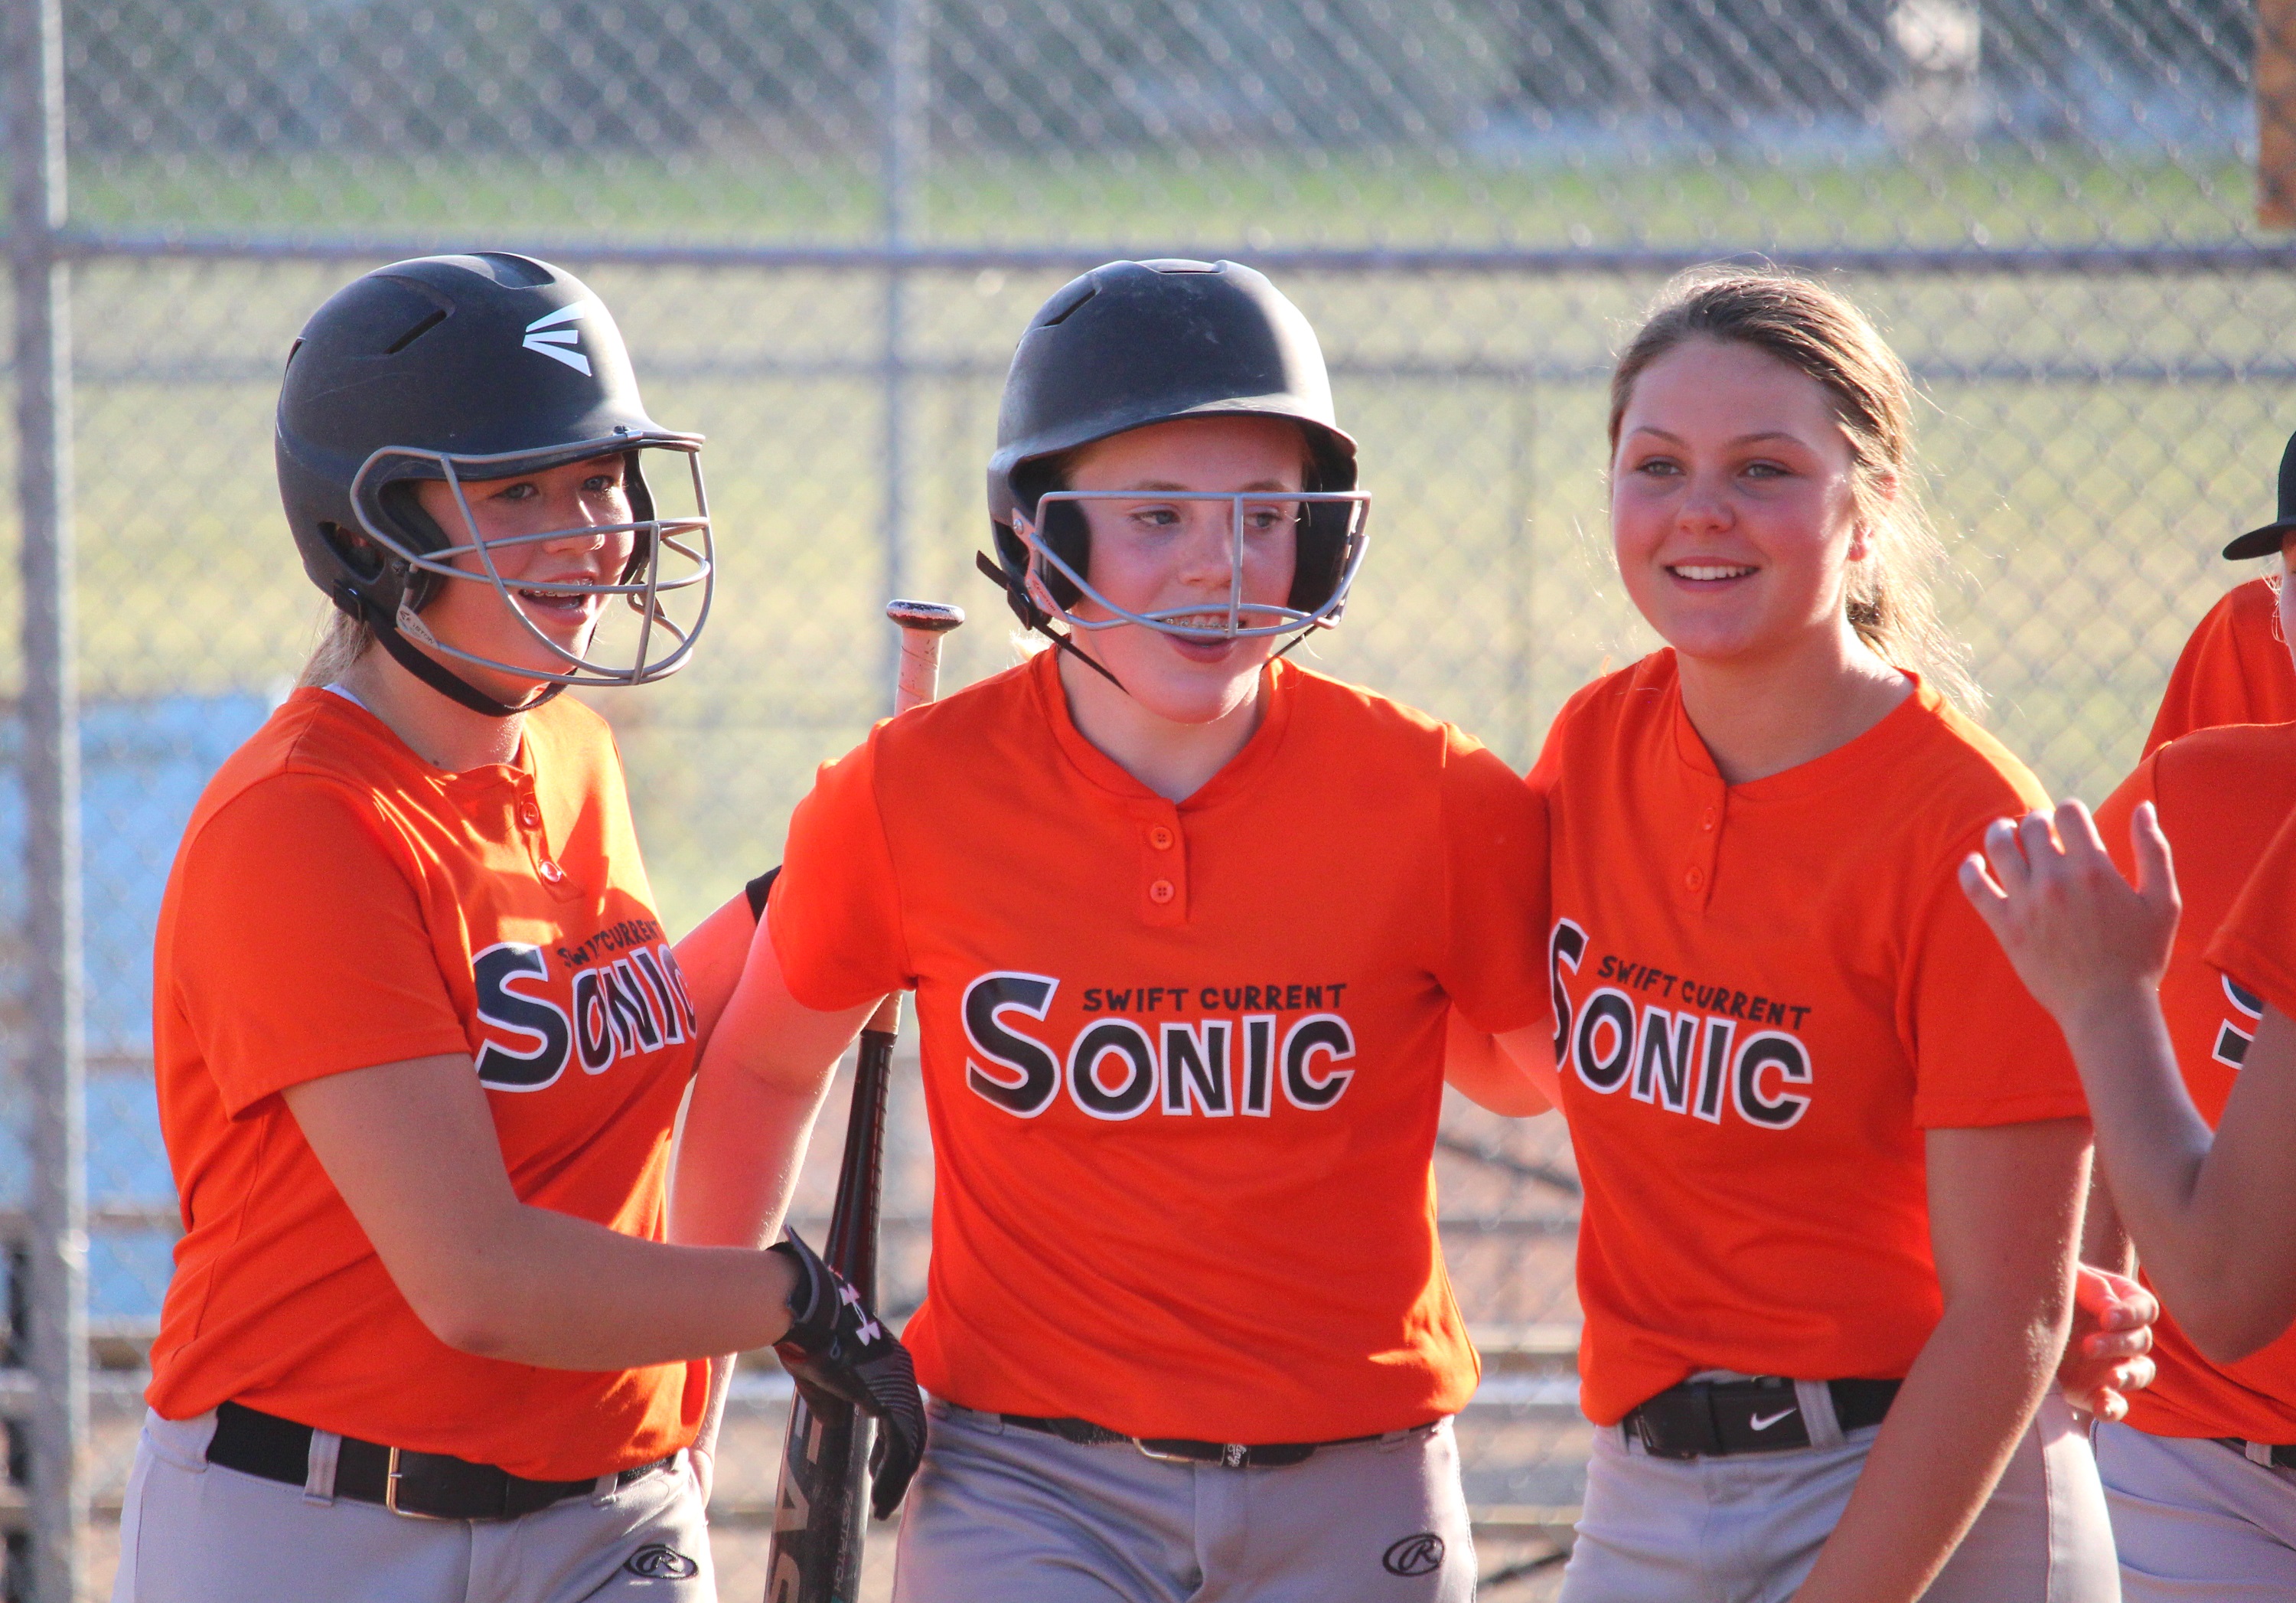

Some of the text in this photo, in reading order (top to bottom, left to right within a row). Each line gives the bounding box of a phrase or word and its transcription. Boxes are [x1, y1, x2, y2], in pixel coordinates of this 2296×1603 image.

[960, 971, 1356, 1121] SONIC
[1082, 984, 1347, 1012] SWIFT CURRENT
[1548, 917, 1814, 1131] SONIC
[1597, 955, 1812, 1030] SWIFT CURRENT
